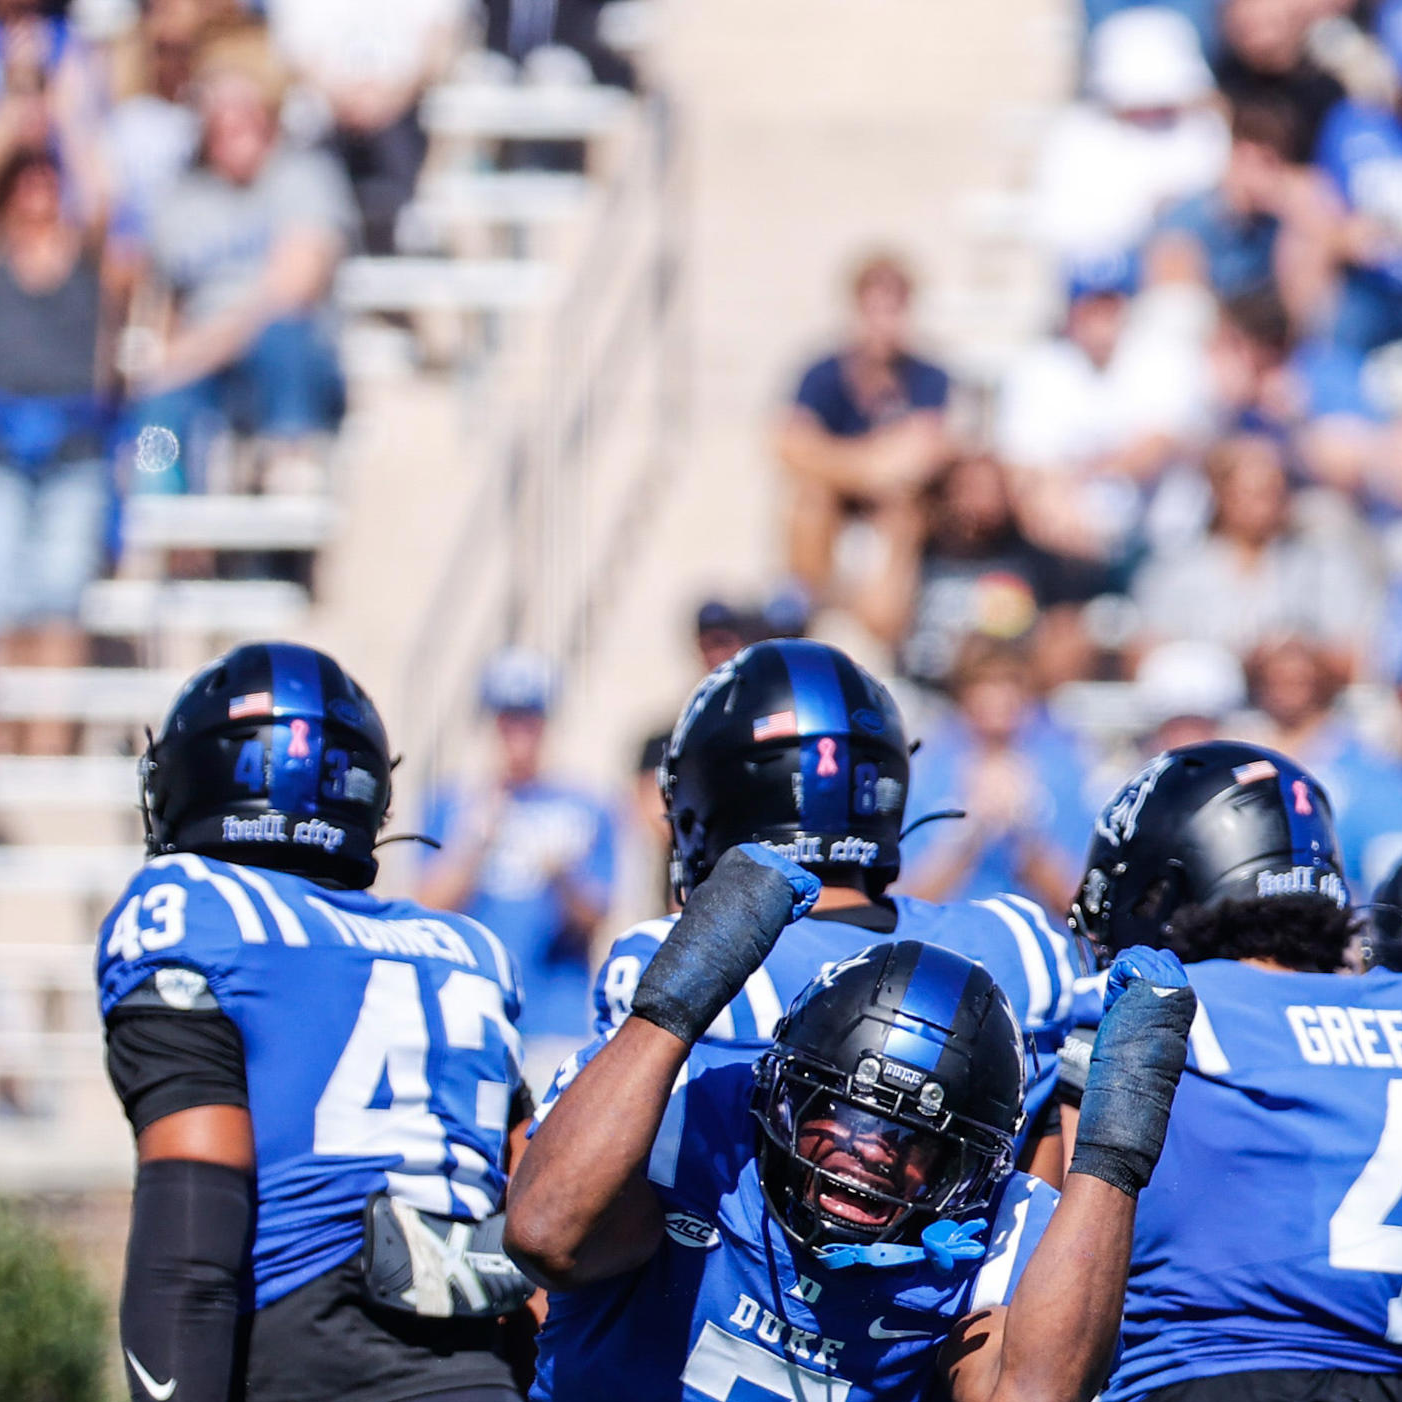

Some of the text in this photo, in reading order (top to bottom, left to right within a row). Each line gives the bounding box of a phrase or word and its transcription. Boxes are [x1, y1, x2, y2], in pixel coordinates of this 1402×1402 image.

[107, 883, 188, 962] 43
[313, 959, 522, 1221] 43
[883, 1061, 923, 1086] DUKE
[662, 1217, 715, 1241] ACC
[790, 1273, 823, 1304] D
[729, 1292, 847, 1370] DUKE
